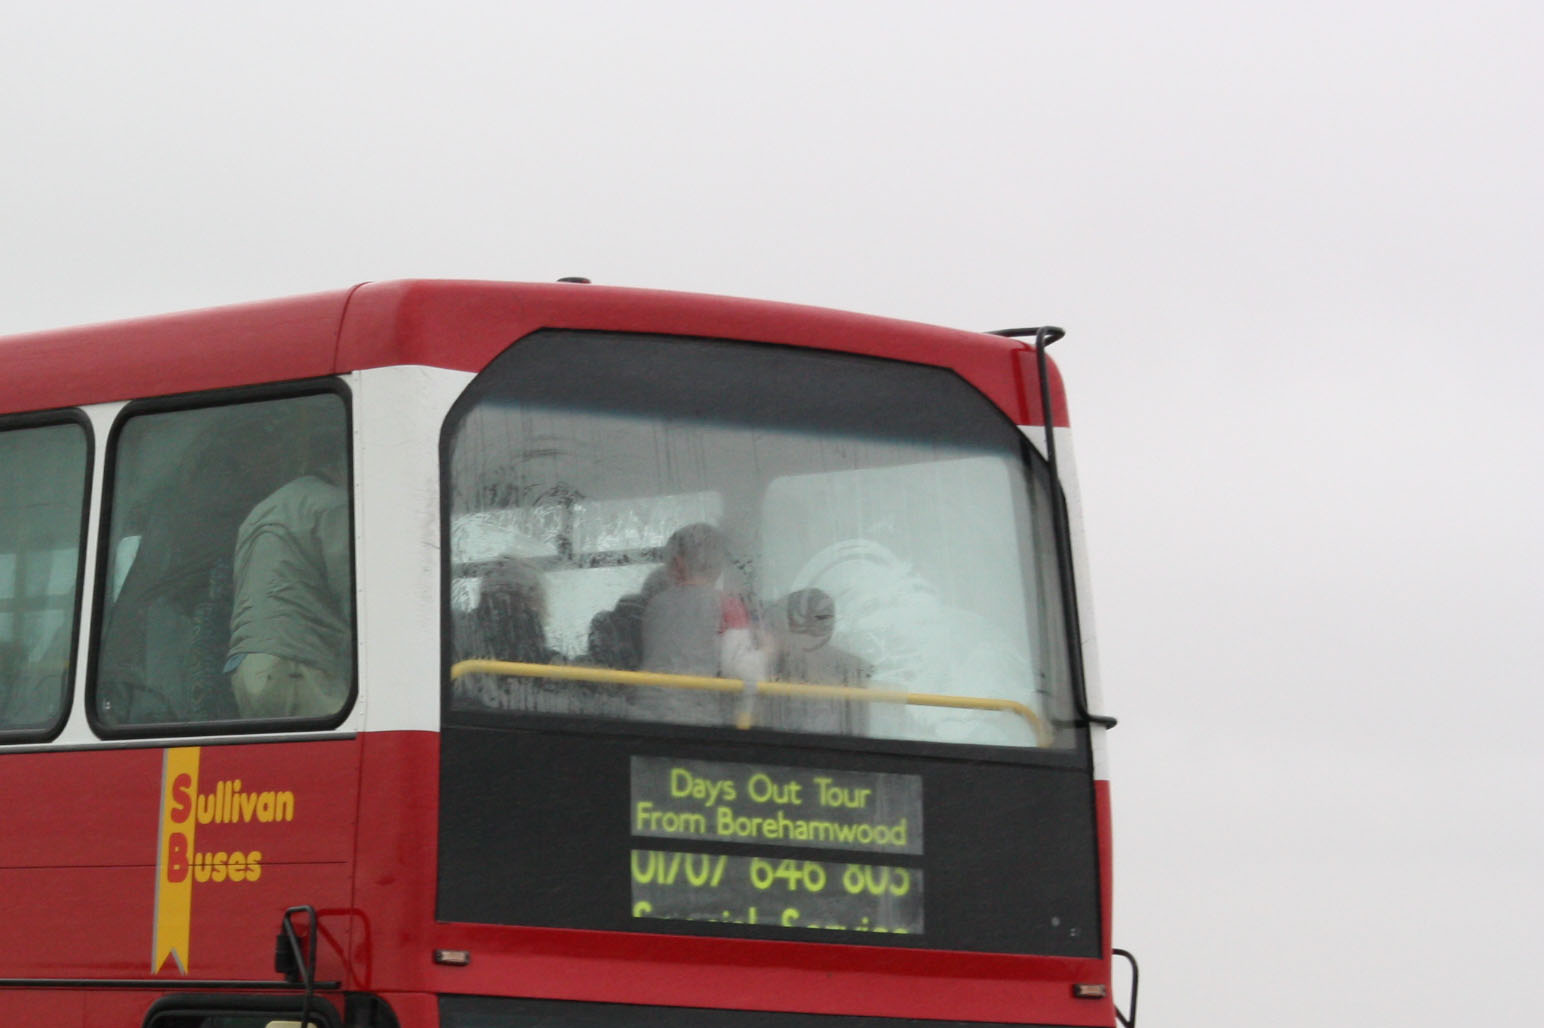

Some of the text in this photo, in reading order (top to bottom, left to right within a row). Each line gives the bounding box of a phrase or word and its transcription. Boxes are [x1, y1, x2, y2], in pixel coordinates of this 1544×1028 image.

[171, 773, 294, 824] Sullivan
[670, 768, 871, 808] Days Out Tour
[636, 801, 907, 846] From Borehamwood
[167, 832, 262, 883] Buses
[750, 857, 826, 892] 646
